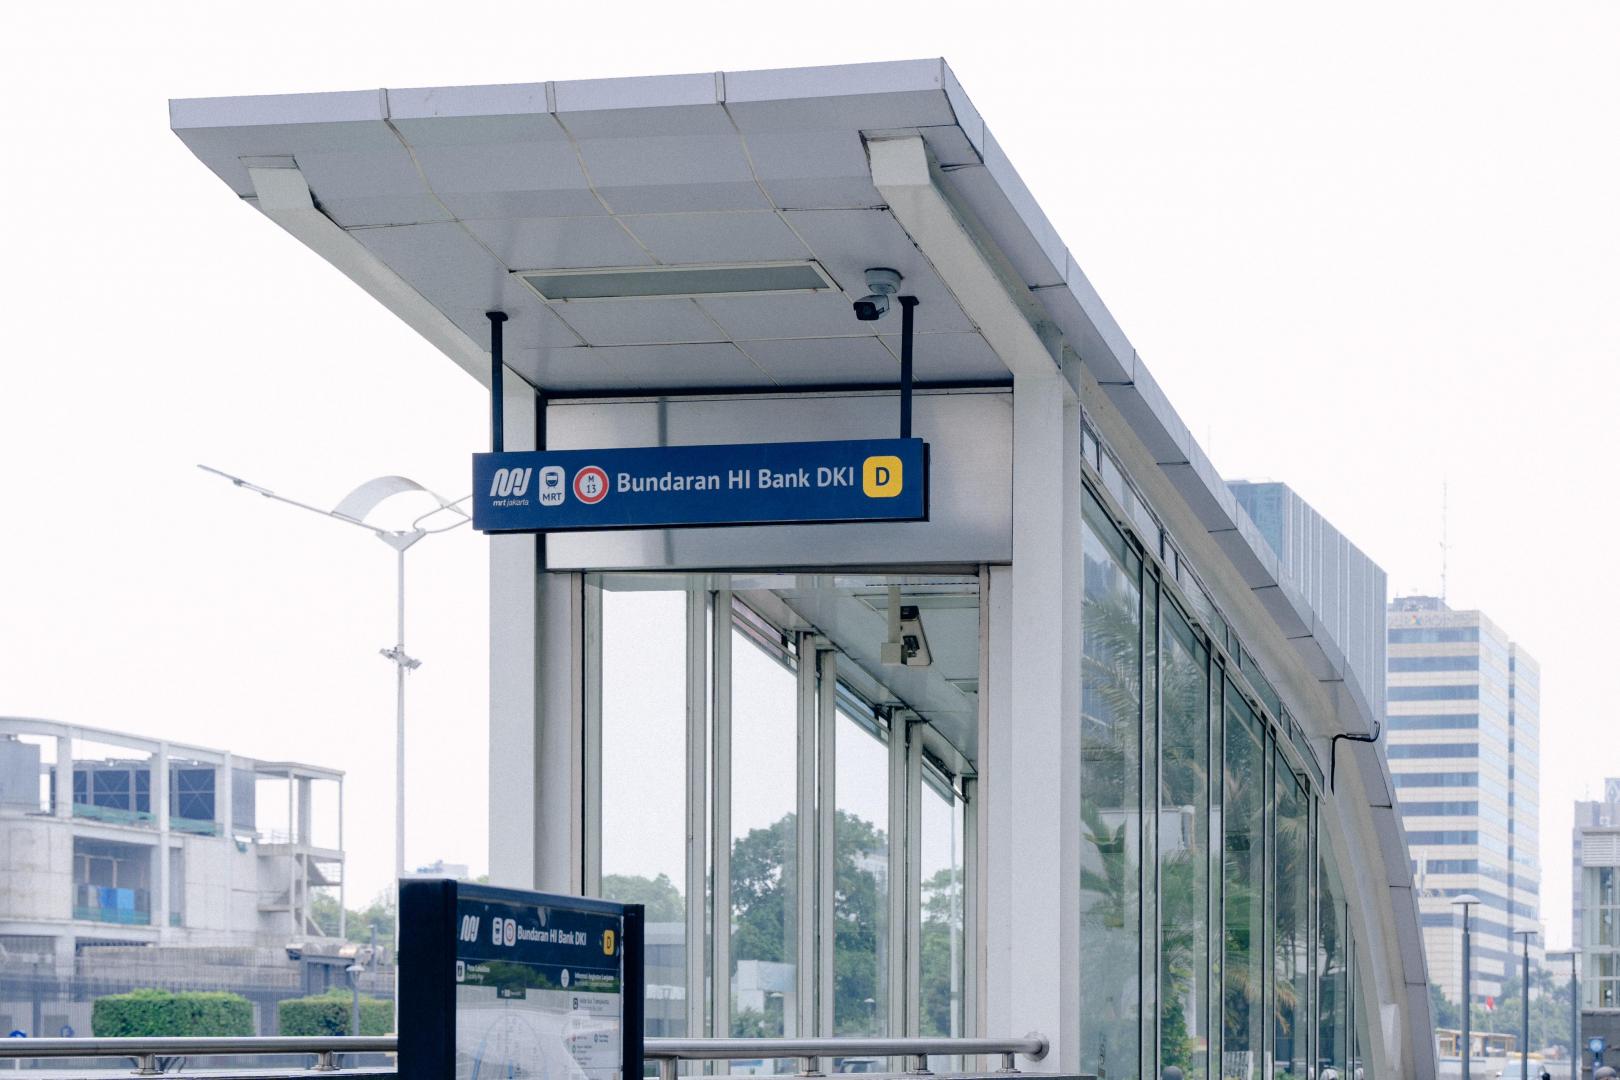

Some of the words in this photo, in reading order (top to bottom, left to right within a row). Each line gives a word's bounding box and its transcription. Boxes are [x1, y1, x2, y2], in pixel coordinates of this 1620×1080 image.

[617, 471, 720, 492] Bundaran
[728, 469, 750, 490] HI
[758, 467, 810, 489] Bank
[817, 466, 854, 488] DKI
[875, 467, 890, 486] D
[586, 484, 597, 494] 13
[493, 499, 506, 507] mrt
[542, 492, 562, 502] MRT
[517, 925, 549, 942] Bundaran
[550, 928, 558, 944] HI
[558, 929, 574, 945] Bank
[574, 931, 587, 946] DKI
